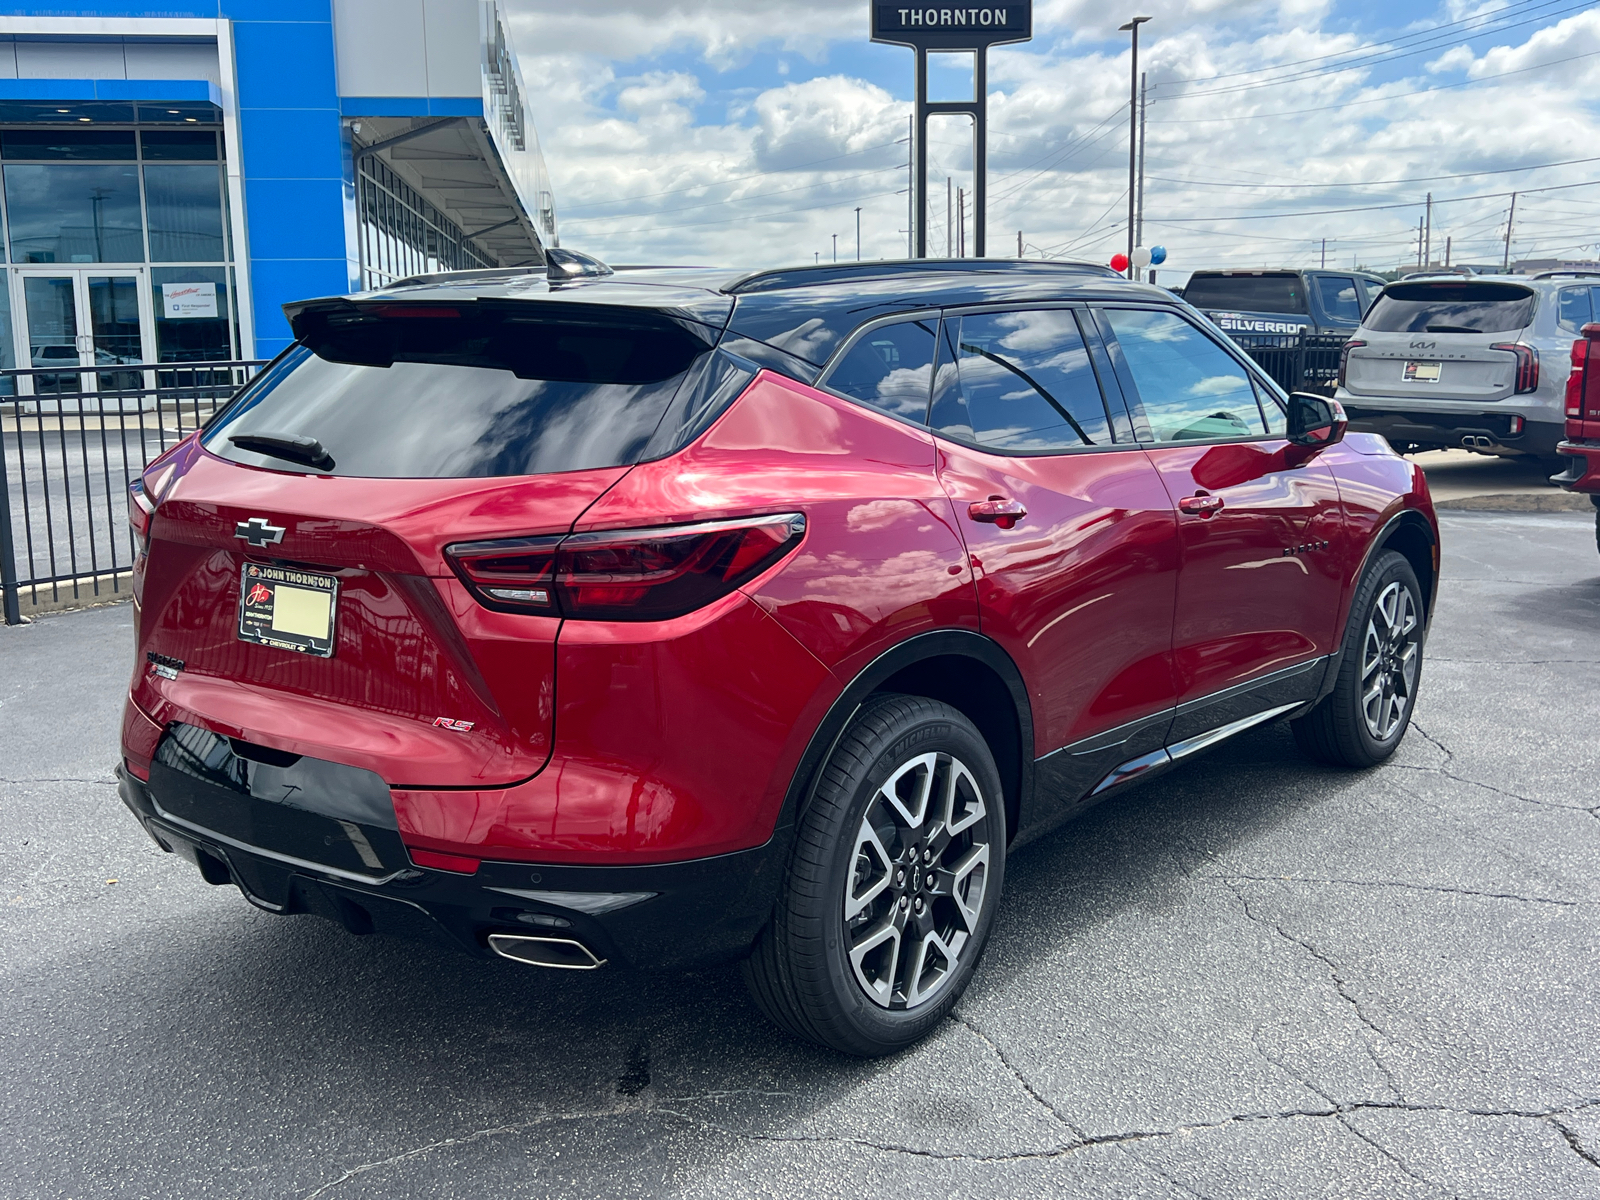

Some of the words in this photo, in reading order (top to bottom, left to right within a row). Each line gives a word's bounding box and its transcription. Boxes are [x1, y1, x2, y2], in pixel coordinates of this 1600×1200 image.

[898, 9, 1007, 26] THORNTON
[1409, 341, 1437, 349] KIA
[263, 568, 285, 581] JOHN
[285, 572, 331, 588] THORNTON
[269, 640, 297, 651] CHEVROLET
[432, 716, 475, 732] RS
[894, 726, 949, 754] MICHELIN
